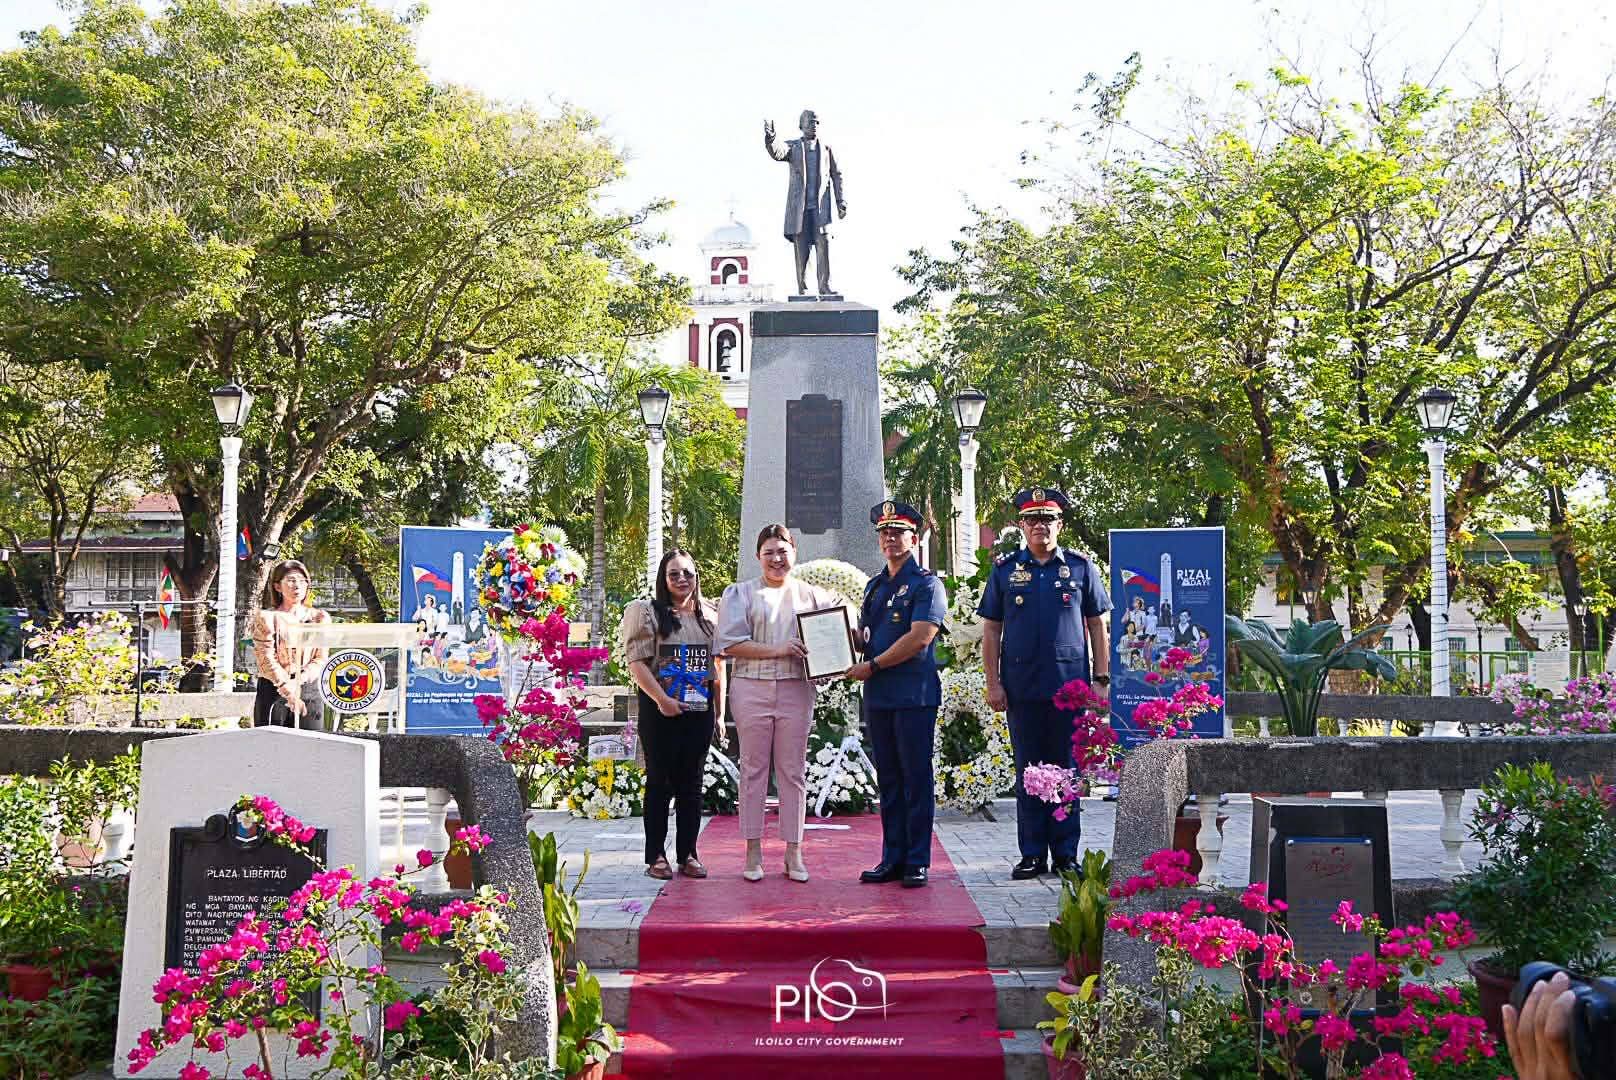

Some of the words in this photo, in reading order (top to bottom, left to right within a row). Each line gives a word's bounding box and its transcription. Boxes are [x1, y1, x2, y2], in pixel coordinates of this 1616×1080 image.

[1176, 569, 1211, 580] RIZAL
[327, 658, 341, 672] CITY
[354, 654, 376, 671] ILOILO
[327, 692, 376, 709] PHILIPPINES
[207, 869, 238, 879] PLAZA
[243, 869, 287, 879] LIBERTAD
[208, 895, 245, 903] BANTAYOG
[248, 895, 259, 903] NG
[185, 902, 197, 910] NG
[228, 903, 253, 911] BAYANI
[185, 911, 203, 919] DITO
[207, 911, 243, 919] NAGTIPON
[185, 919, 216, 927] WATAWAT
